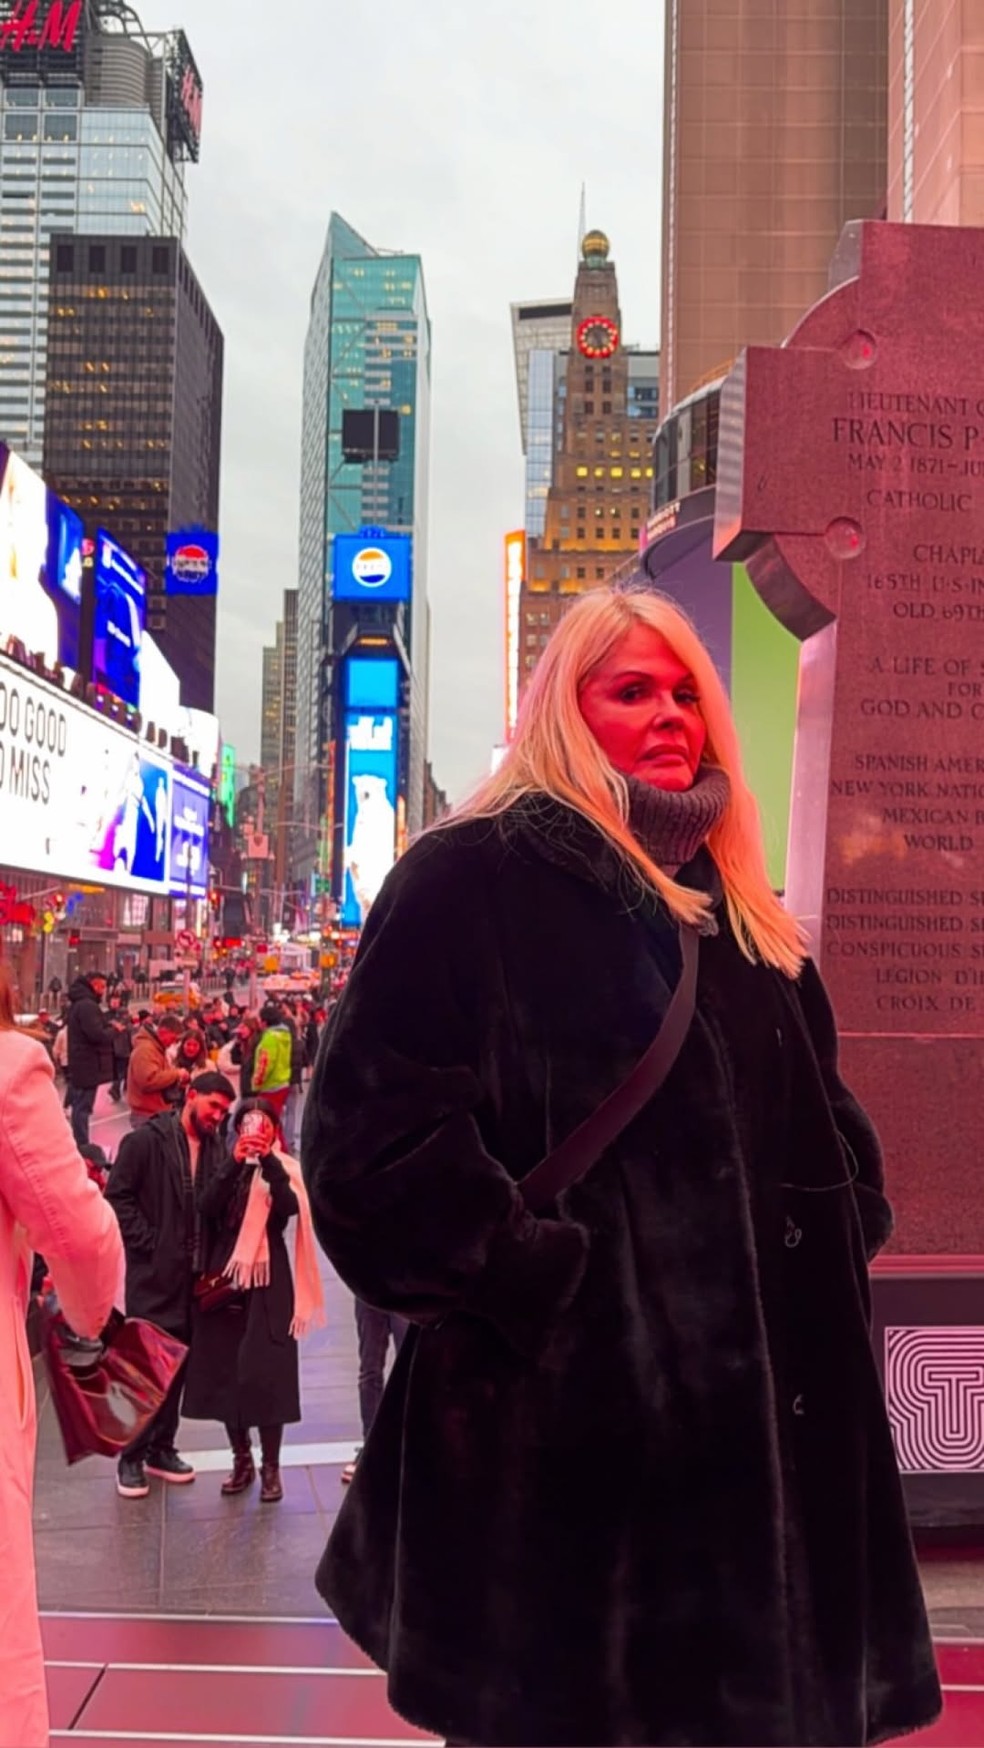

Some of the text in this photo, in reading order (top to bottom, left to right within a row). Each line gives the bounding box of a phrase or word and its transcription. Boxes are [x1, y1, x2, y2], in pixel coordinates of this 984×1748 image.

[833, 417, 953, 449] FRANCIS
[849, 453, 884, 471] MAY
[867, 489, 972, 512] CATHOLIC
[867, 573, 921, 592] 165TH
[893, 602, 934, 620] OLD
[869, 657, 884, 673] A
[893, 658, 935, 675] LIFE
[943, 659, 972, 676] OF
[948, 682, 983, 698] FOR
[861, 699, 910, 716] GOD
[917, 701, 963, 719] AND
[25, 696, 67, 758] GOOD
[855, 754, 928, 772] SPANISH
[9, 745, 51, 805] MISS
[830, 779, 874, 796] NEW
[879, 781, 929, 798] YORK
[882, 807, 969, 824] MEXICAN
[904, 834, 974, 851] WORLD
[827, 888, 963, 906] DISTINGUISHED
[827, 914, 963, 932] DISTINGUISHED
[827, 940, 962, 958] CONSPICUOUS
[877, 996, 975, 1012] CROIX DE
